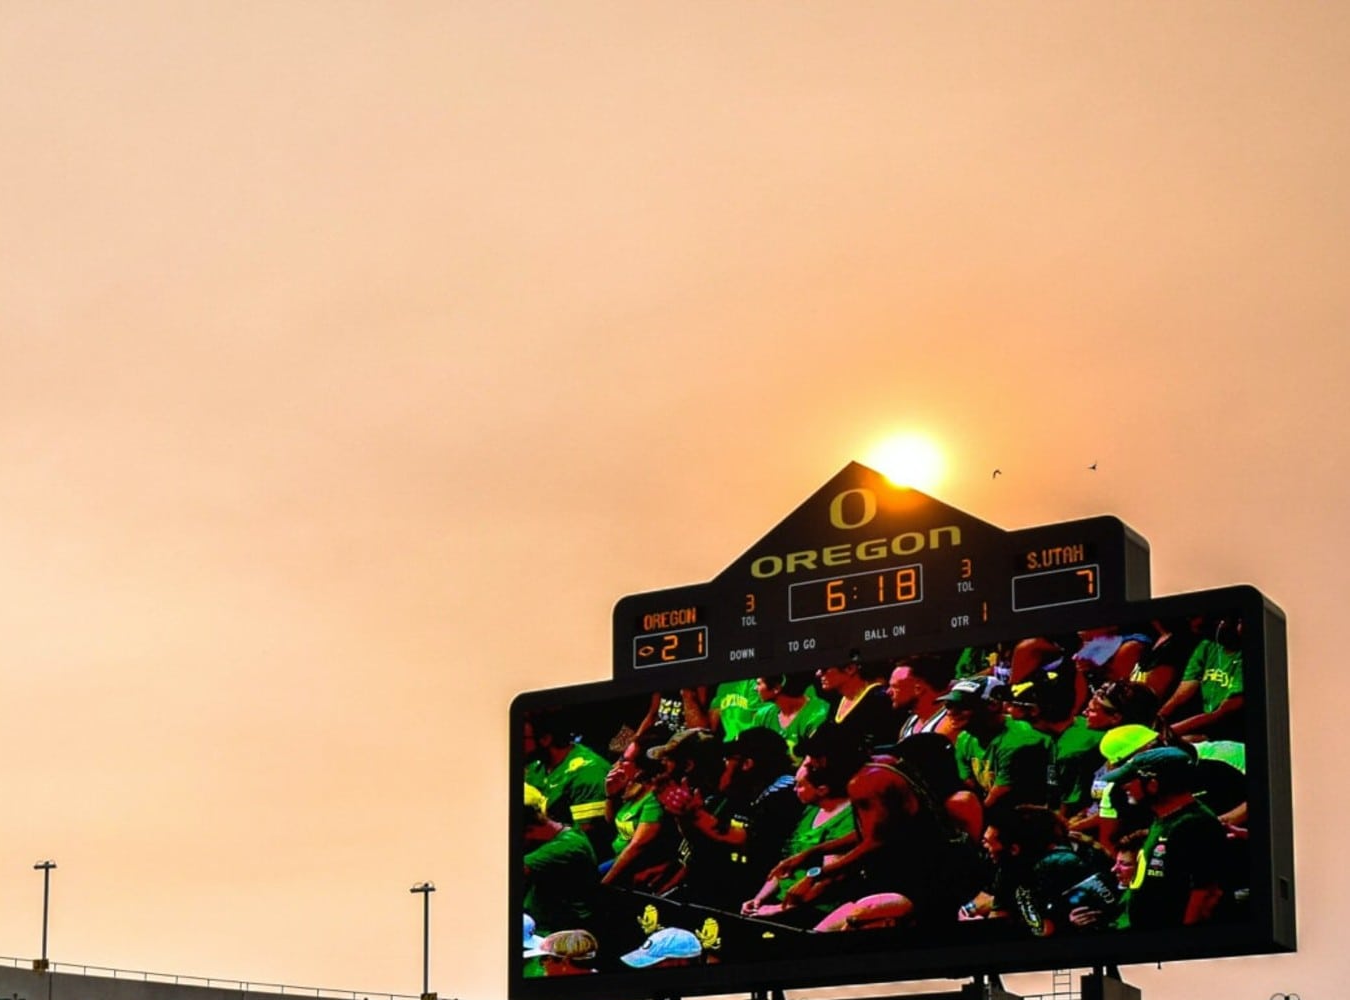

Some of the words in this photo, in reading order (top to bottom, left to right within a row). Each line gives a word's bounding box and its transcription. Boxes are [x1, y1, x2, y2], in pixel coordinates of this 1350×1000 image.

[830, 488, 877, 530] O
[751, 526, 961, 578] OREGON
[1026, 544, 1084, 569] S.UTAH
[962, 559, 971, 578] 3
[827, 569, 916, 612] 6:18
[957, 581, 974, 592] TOL
[1076, 569, 1093, 594] 7
[746, 594, 755, 612] 3
[643, 608, 697, 631] OREGON
[741, 616, 757, 626] TOL
[951, 615, 969, 628] QTR
[864, 629, 887, 641] BALL
[893, 625, 906, 637] ON
[661, 632, 703, 661] 21
[730, 648, 754, 661] DOWN
[788, 641, 799, 652] TO
[803, 639, 816, 650] GO
